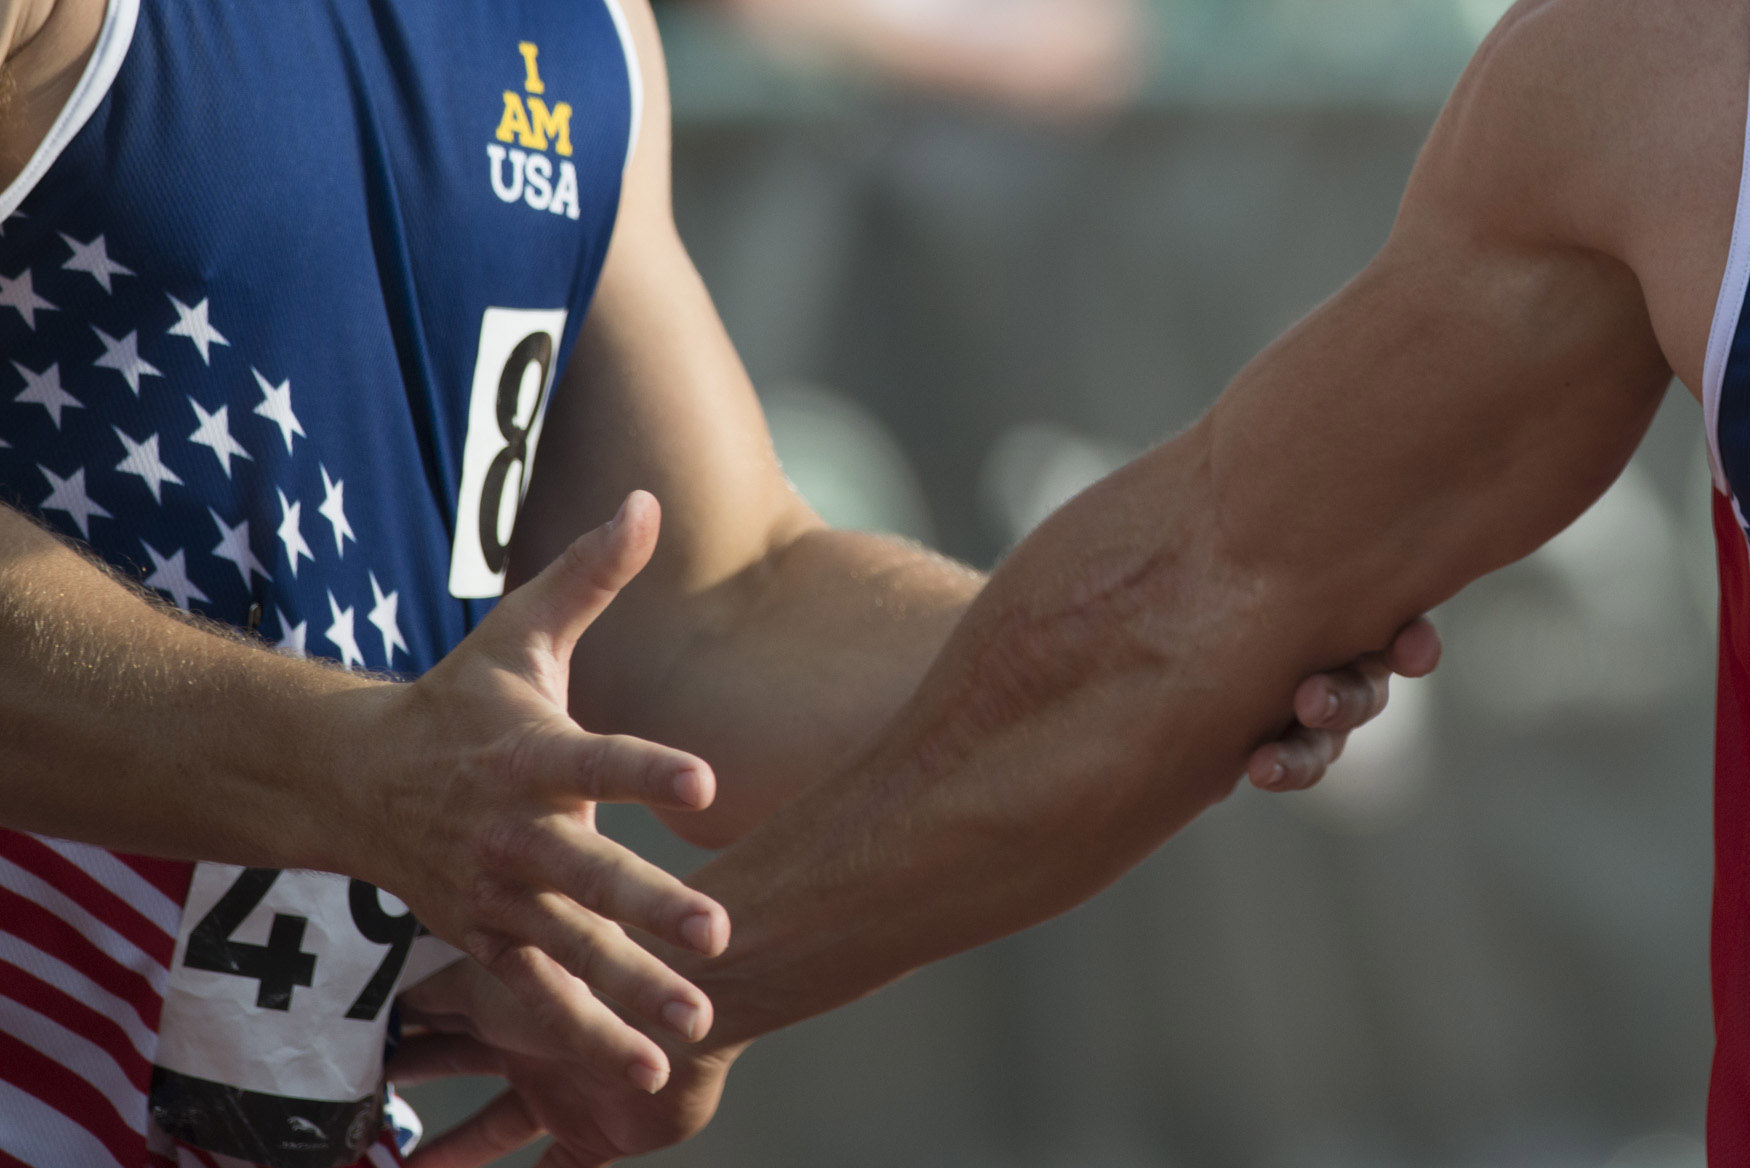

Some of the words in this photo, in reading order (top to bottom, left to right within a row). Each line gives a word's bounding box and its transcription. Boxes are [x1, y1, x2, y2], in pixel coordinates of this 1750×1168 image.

[518, 41, 545, 94] I
[495, 90, 573, 157] AM
[486, 143, 580, 220] USA
[478, 330, 553, 576] 8
